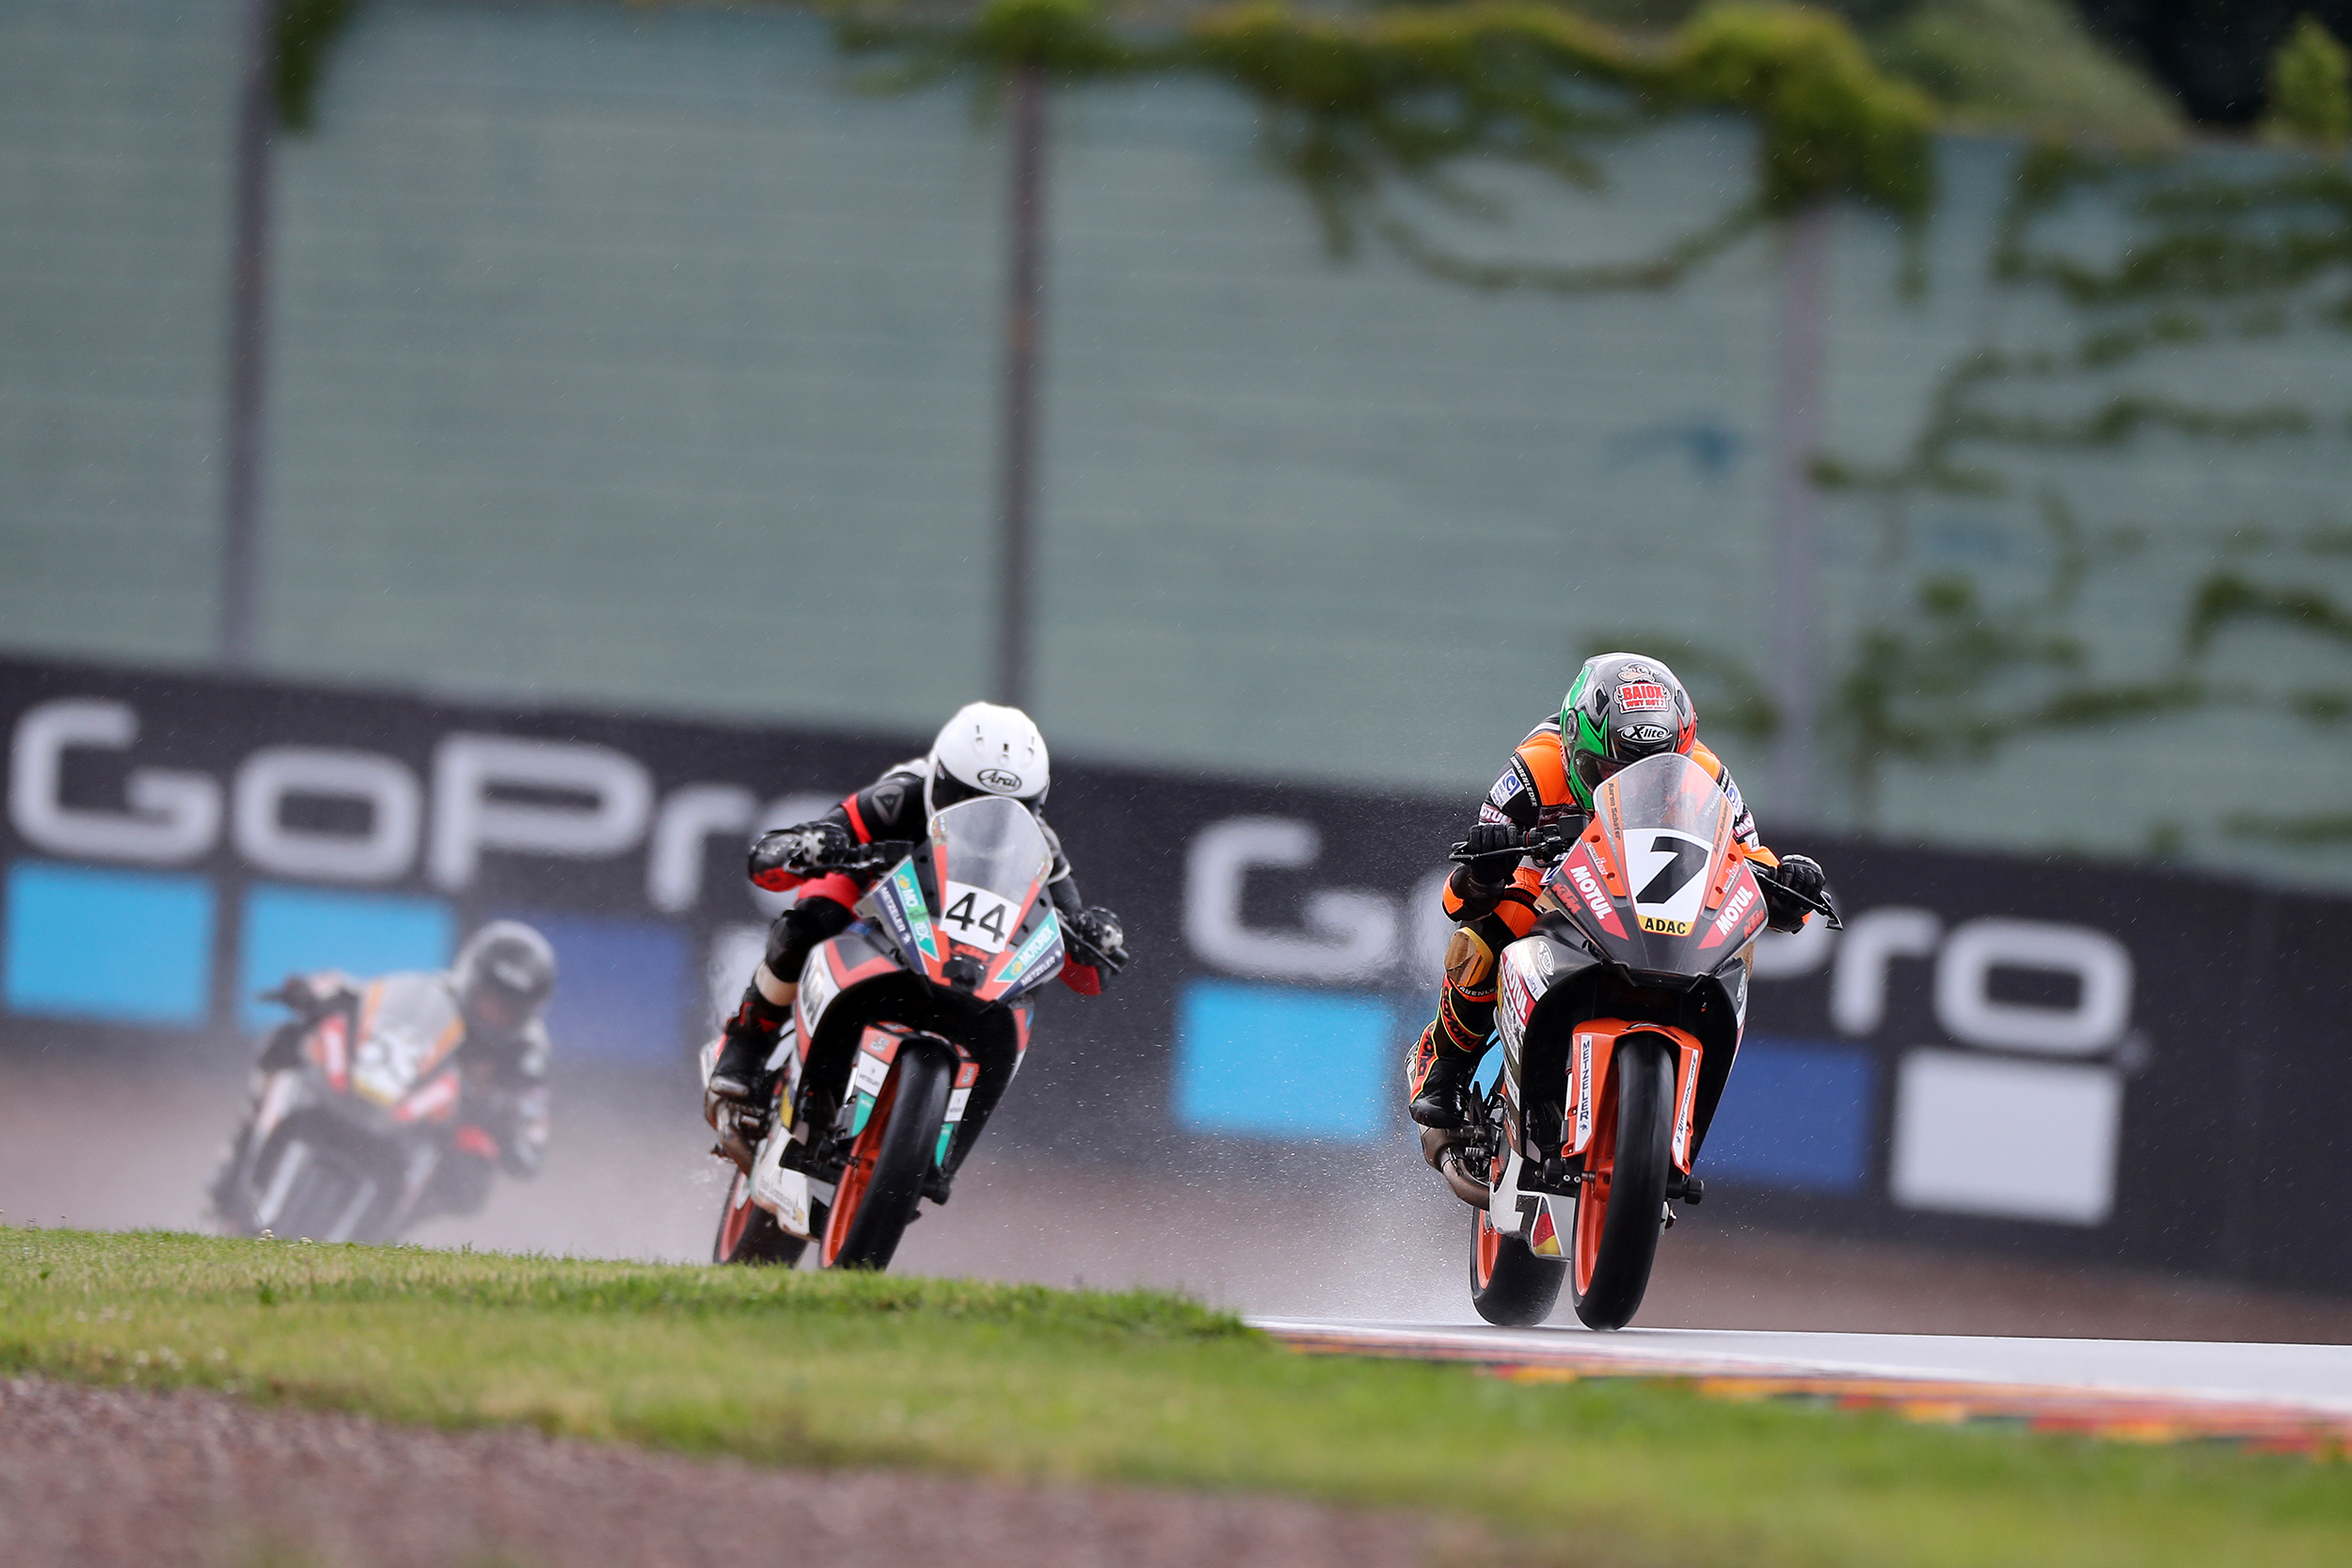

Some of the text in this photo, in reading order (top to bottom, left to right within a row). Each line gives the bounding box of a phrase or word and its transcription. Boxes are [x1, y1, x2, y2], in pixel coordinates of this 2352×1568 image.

[1628, 726, 1664, 740] X-lite
[981, 770, 1017, 787] Arai
[1635, 836, 1708, 904] 7
[881, 886, 905, 932] METZELER
[1552, 882, 1581, 914] KTM
[1569, 865, 1613, 920] MOTUL
[1715, 885, 1754, 936] MOTUL
[946, 892, 1006, 942] 44
[1645, 917, 1686, 934] ADAC
[1018, 925, 1055, 965] MOTOREX
[1021, 956, 1056, 987] METZELER
[1580, 1040, 1590, 1121] METZELER
